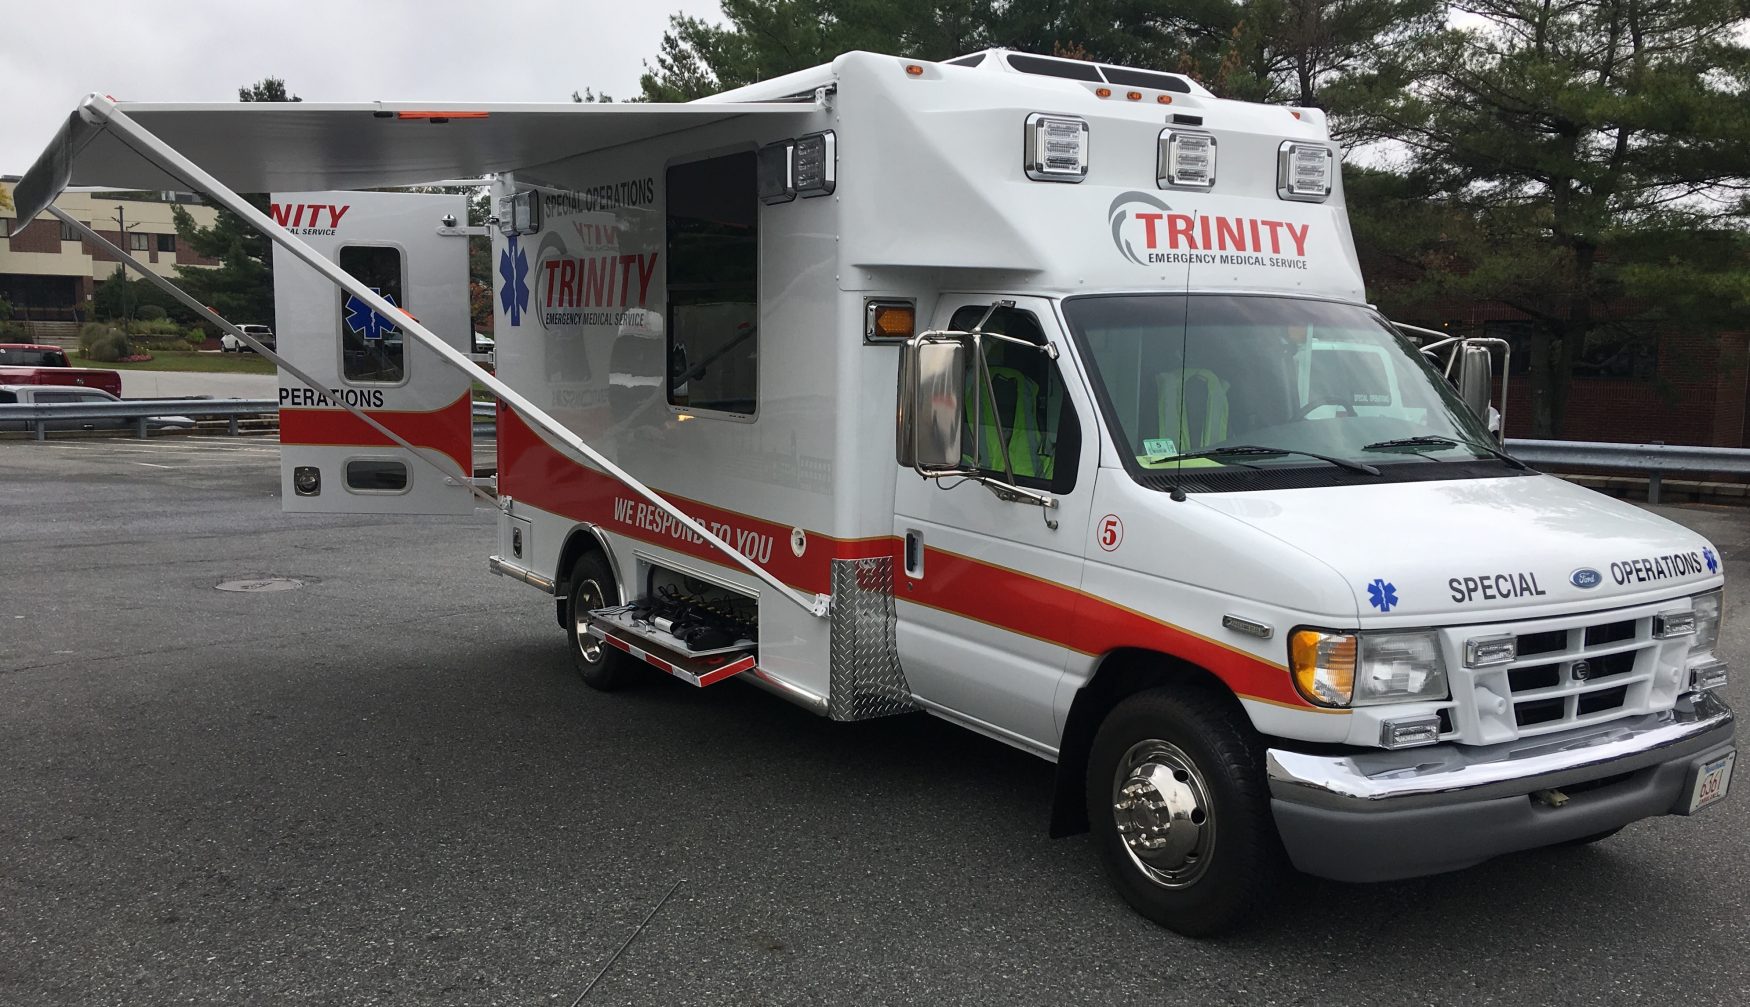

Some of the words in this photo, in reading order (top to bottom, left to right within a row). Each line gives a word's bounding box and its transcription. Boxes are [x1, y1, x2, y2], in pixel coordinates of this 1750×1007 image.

[545, 193, 585, 218] SPECIAL
[586, 177, 654, 212] OPERATIONS
[302, 228, 336, 236] SERVICE
[1135, 212, 1310, 257] TRINITY
[545, 251, 659, 308] TRINITY
[1148, 252, 1216, 265] EMERGENCY
[1219, 254, 1267, 267] MEDICAL
[1269, 256, 1308, 270] SERVICE
[545, 312, 582, 326] EMERGENCY
[583, 312, 613, 327] MEDICAL
[614, 312, 644, 327] SERVICE
[614, 497, 635, 525] WE
[736, 528, 774, 564] YOU
[1102, 520, 1117, 546] 5
[1448, 571, 1547, 604] SPECIAL
[1578, 571, 1596, 585] Ford
[1610, 552, 1704, 586] OPERATIONS
